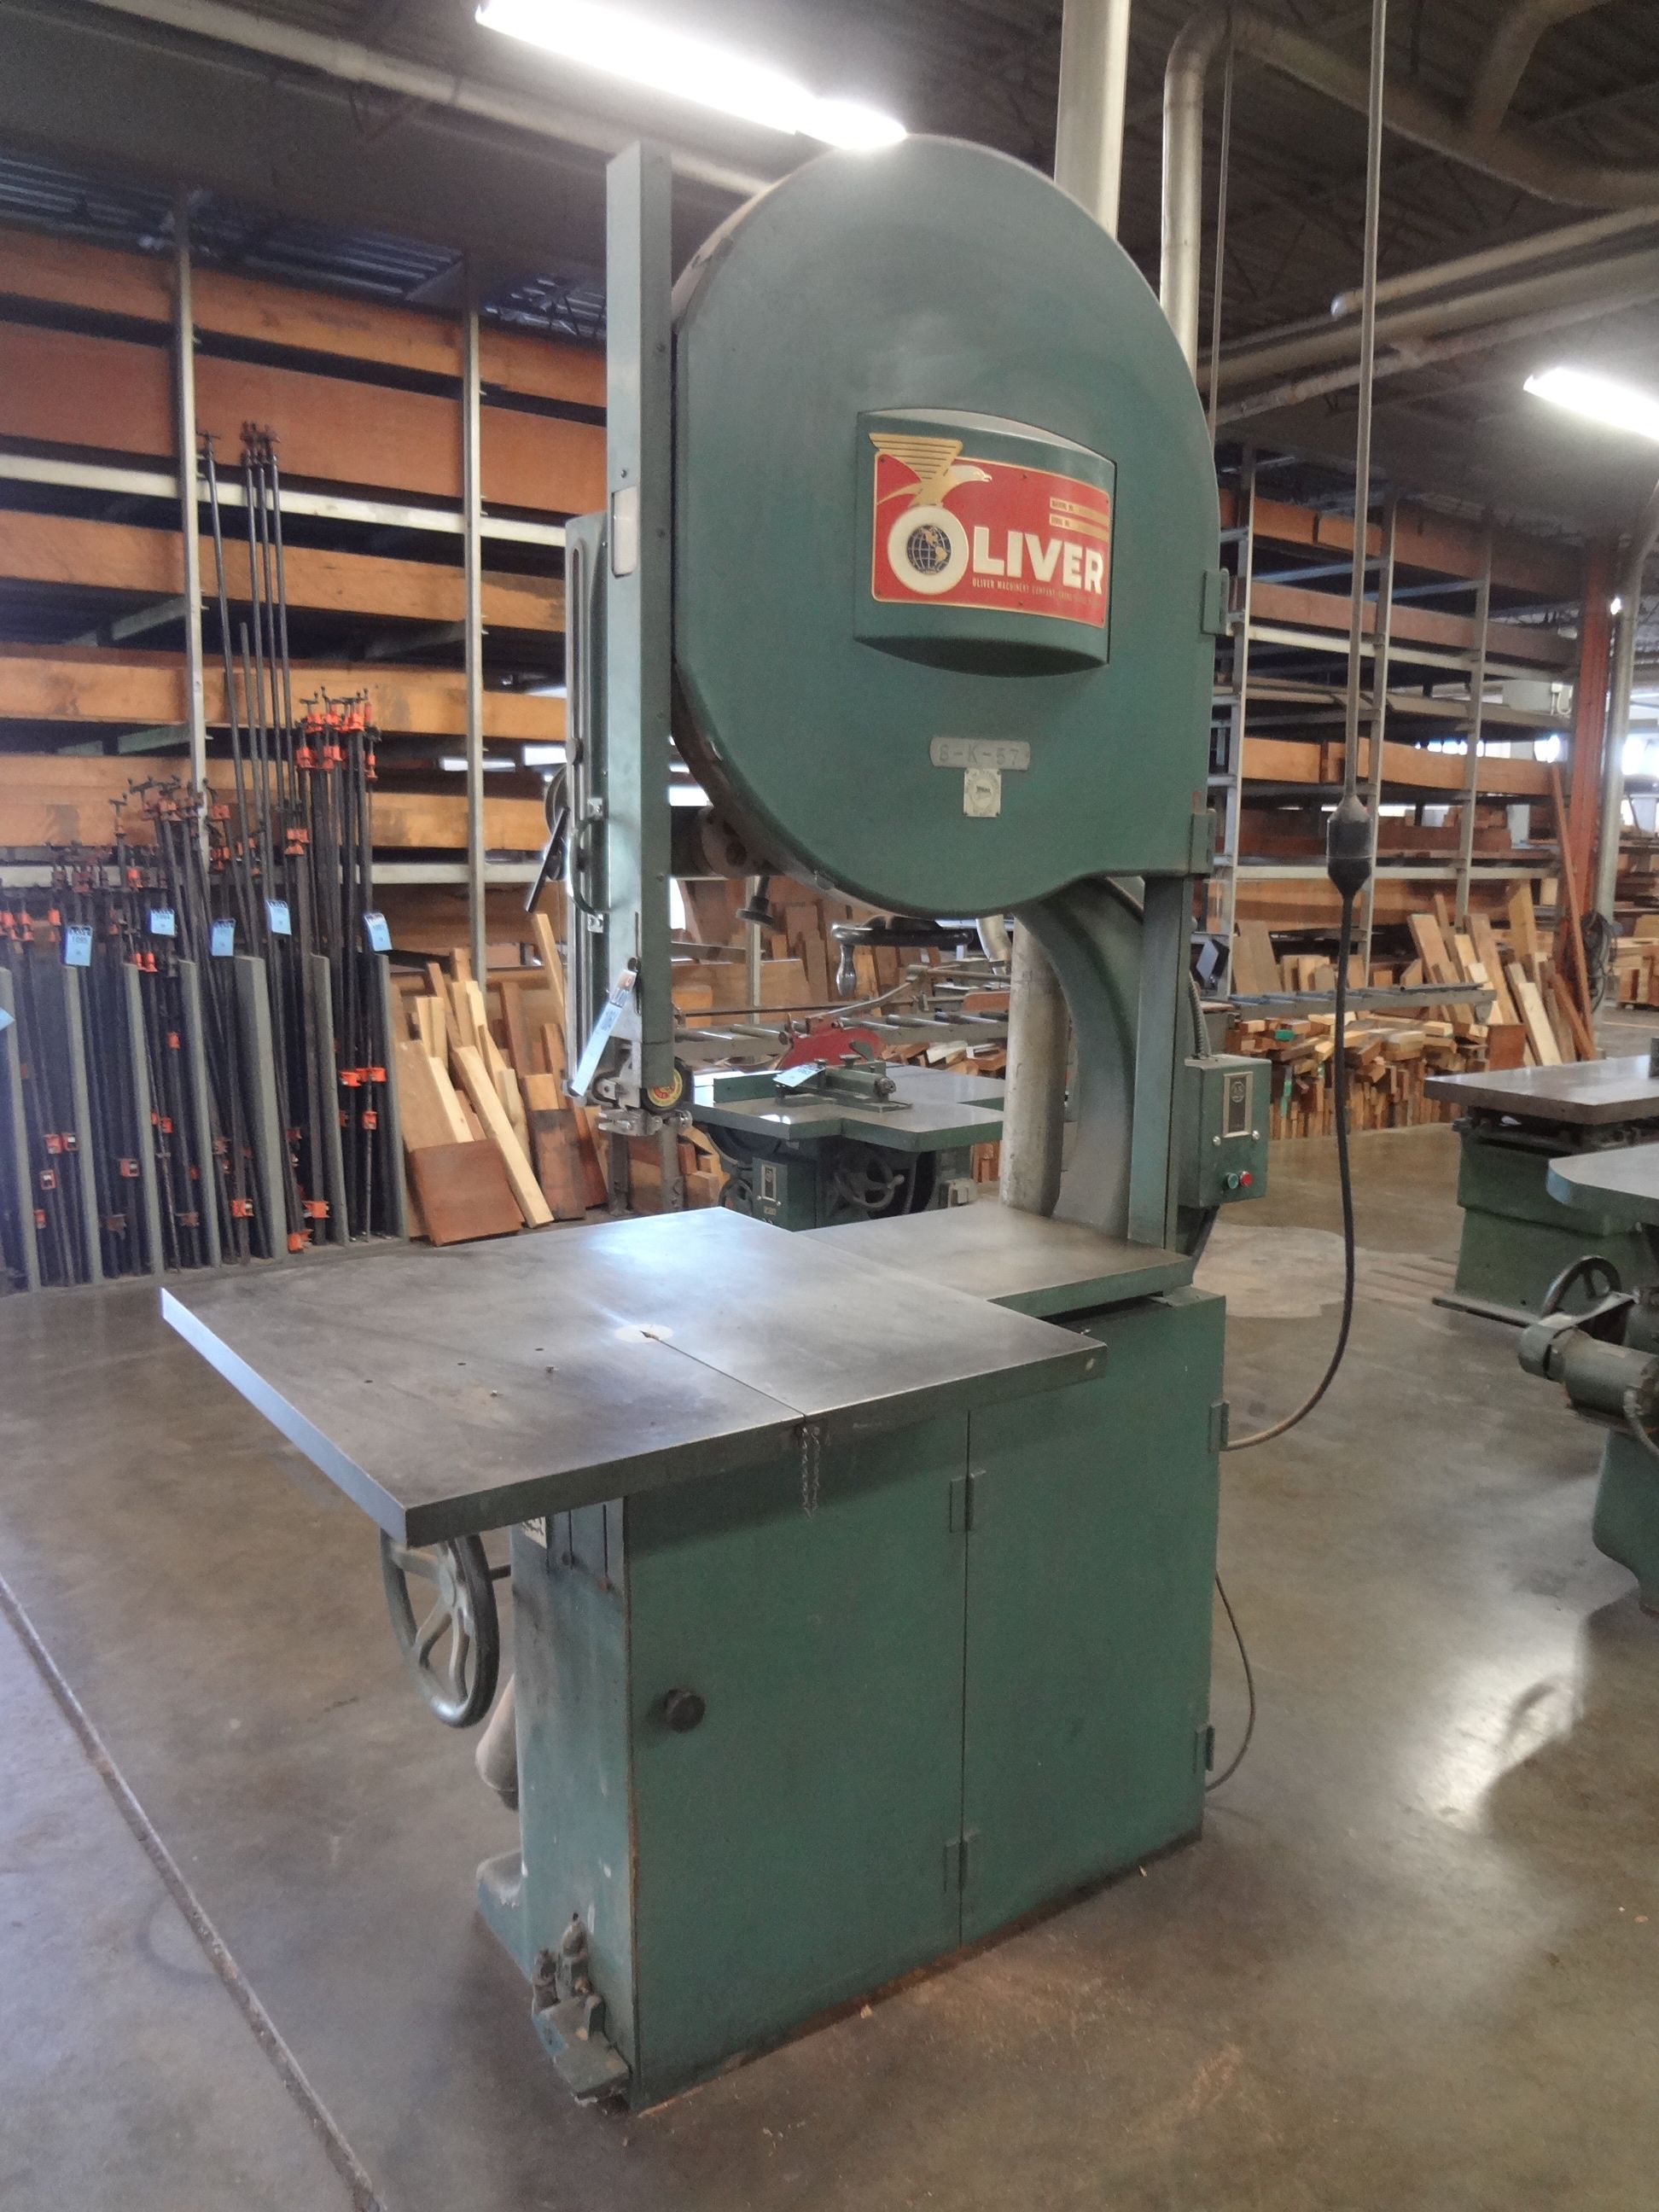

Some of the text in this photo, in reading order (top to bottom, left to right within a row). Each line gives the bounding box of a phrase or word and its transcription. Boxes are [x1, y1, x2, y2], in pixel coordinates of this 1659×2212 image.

[888, 505, 1103, 595] OLIVER
[972, 578, 994, 589] OLIVER
[997, 580, 1030, 593] MACHINERY
